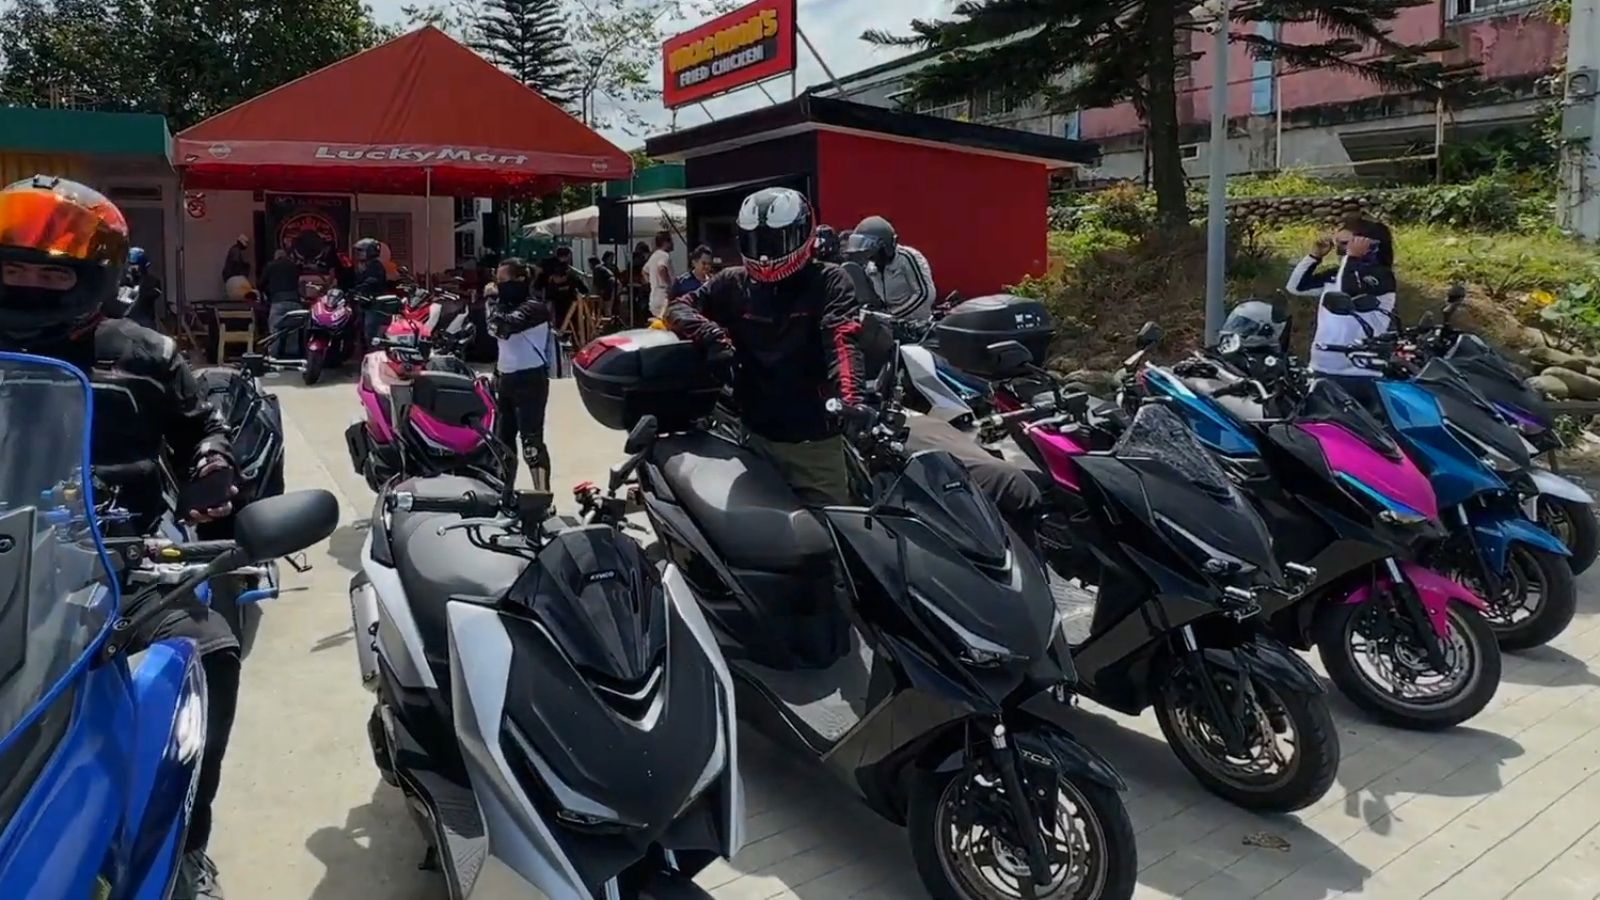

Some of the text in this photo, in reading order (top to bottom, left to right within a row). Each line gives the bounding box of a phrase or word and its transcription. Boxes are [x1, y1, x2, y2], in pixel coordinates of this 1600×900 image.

[680, 45, 764, 87] FRIED CHICKEN
[315, 146, 528, 165] LuckyMart
[1021, 749, 1053, 766] TCS
